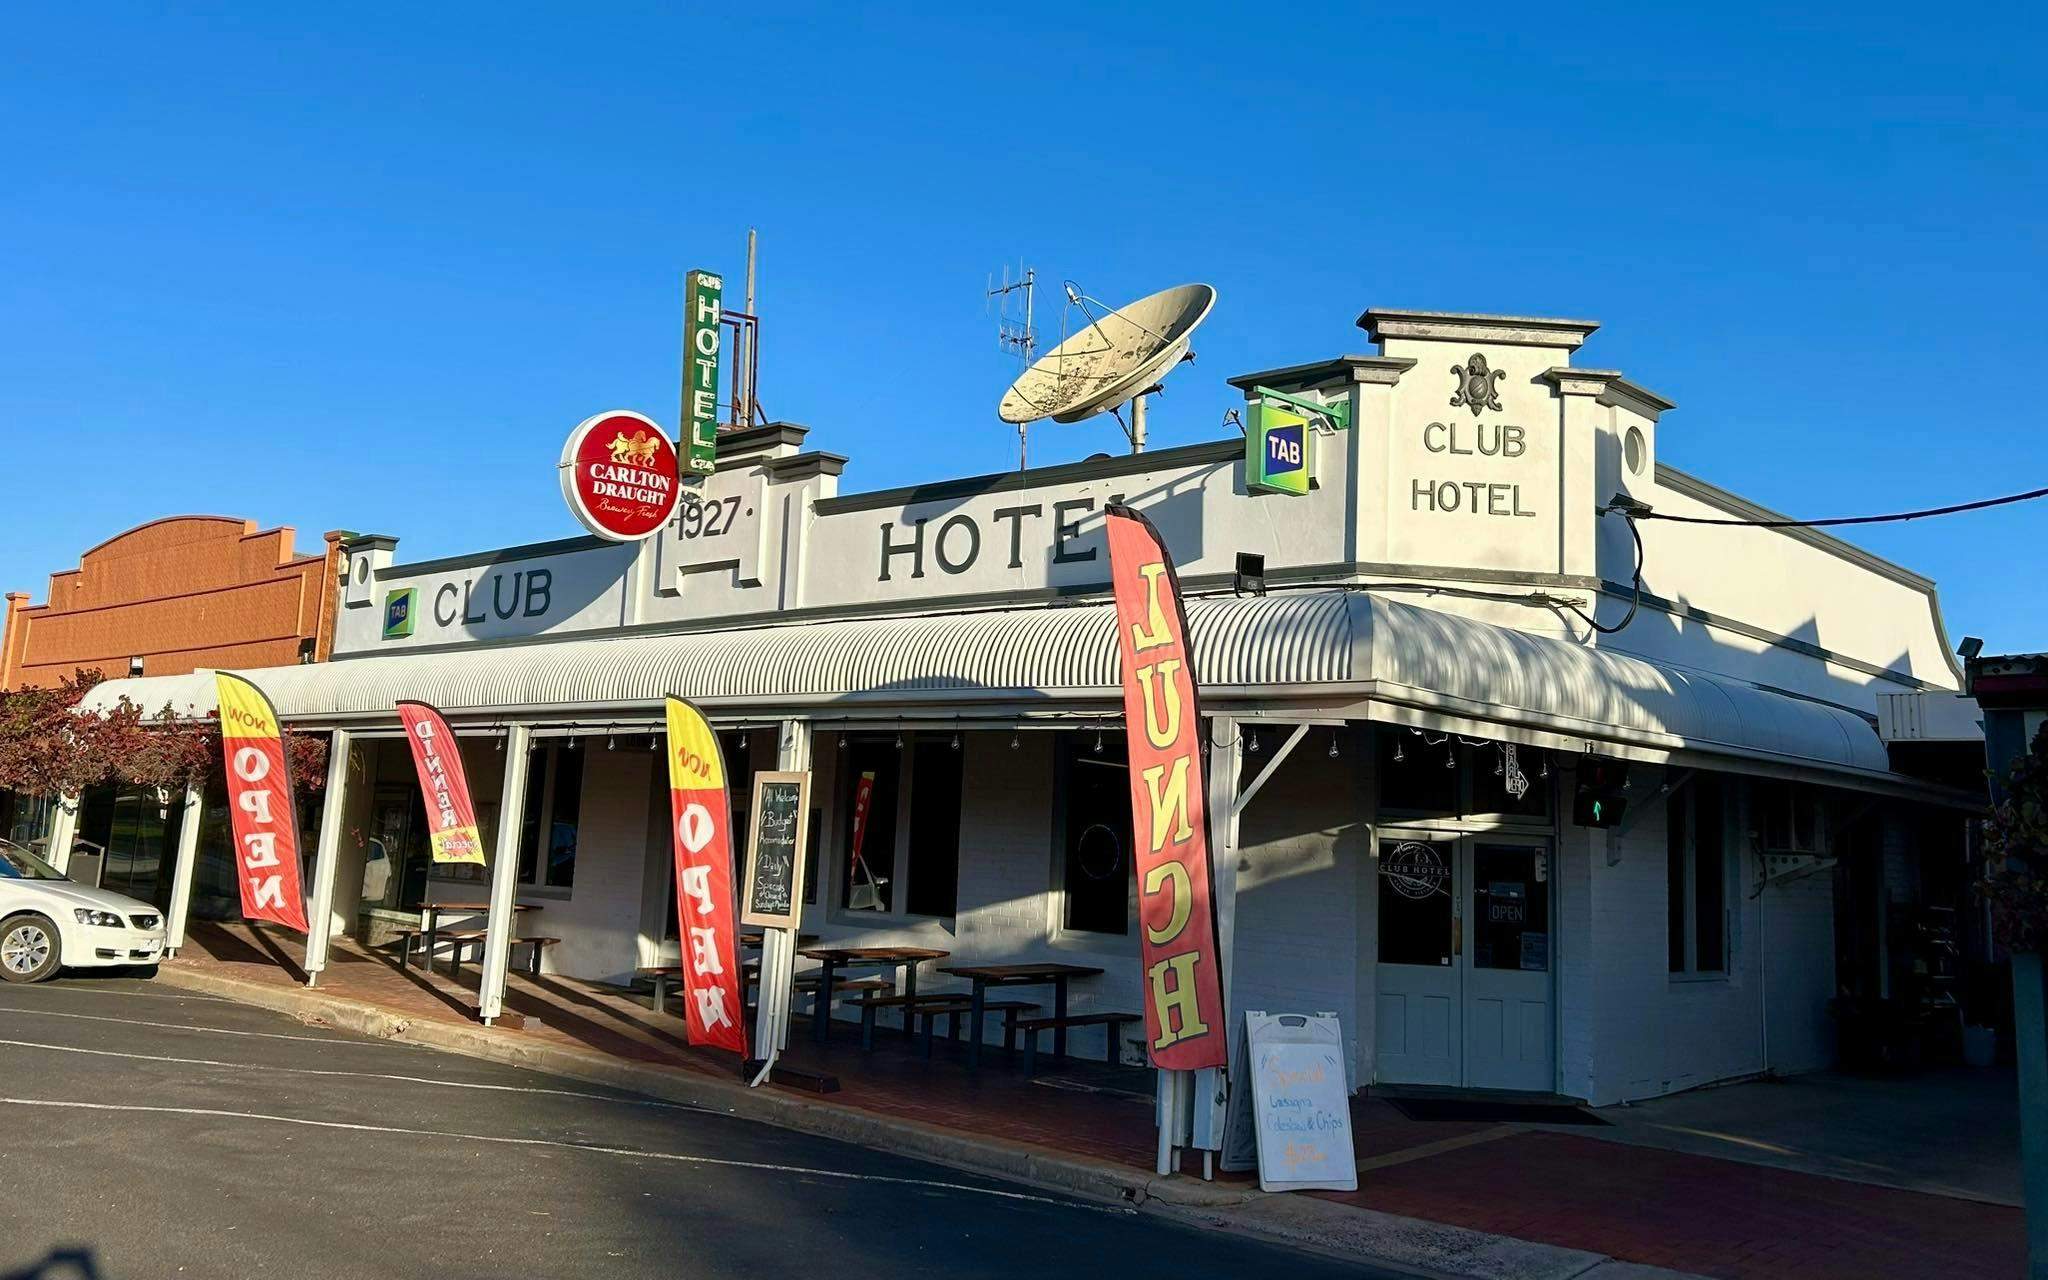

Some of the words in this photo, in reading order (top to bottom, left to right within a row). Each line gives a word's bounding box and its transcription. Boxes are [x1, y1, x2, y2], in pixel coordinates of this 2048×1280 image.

[692, 294, 720, 448] HOTEL
[1268, 435, 1300, 464] TAB
[1424, 422, 1526, 458] CLUB
[590, 462, 671, 492] CARLTON
[592, 481, 667, 506] DRAUGHT
[1412, 479, 1536, 517] HOTEL
[596, 498, 636, 522] Brewery
[636, 505, 658, 519] Fresh
[678, 496, 742, 540] 1927
[878, 493, 1125, 582] HOTE
[391, 604, 408, 618] TAB
[434, 568, 552, 627] CLUB
[1380, 864, 1408, 874] CLUB
[1414, 866, 1450, 876] HOTEL
[1492, 904, 1522, 921] OPEN
[1315, 1110, 1344, 1139] Chips
